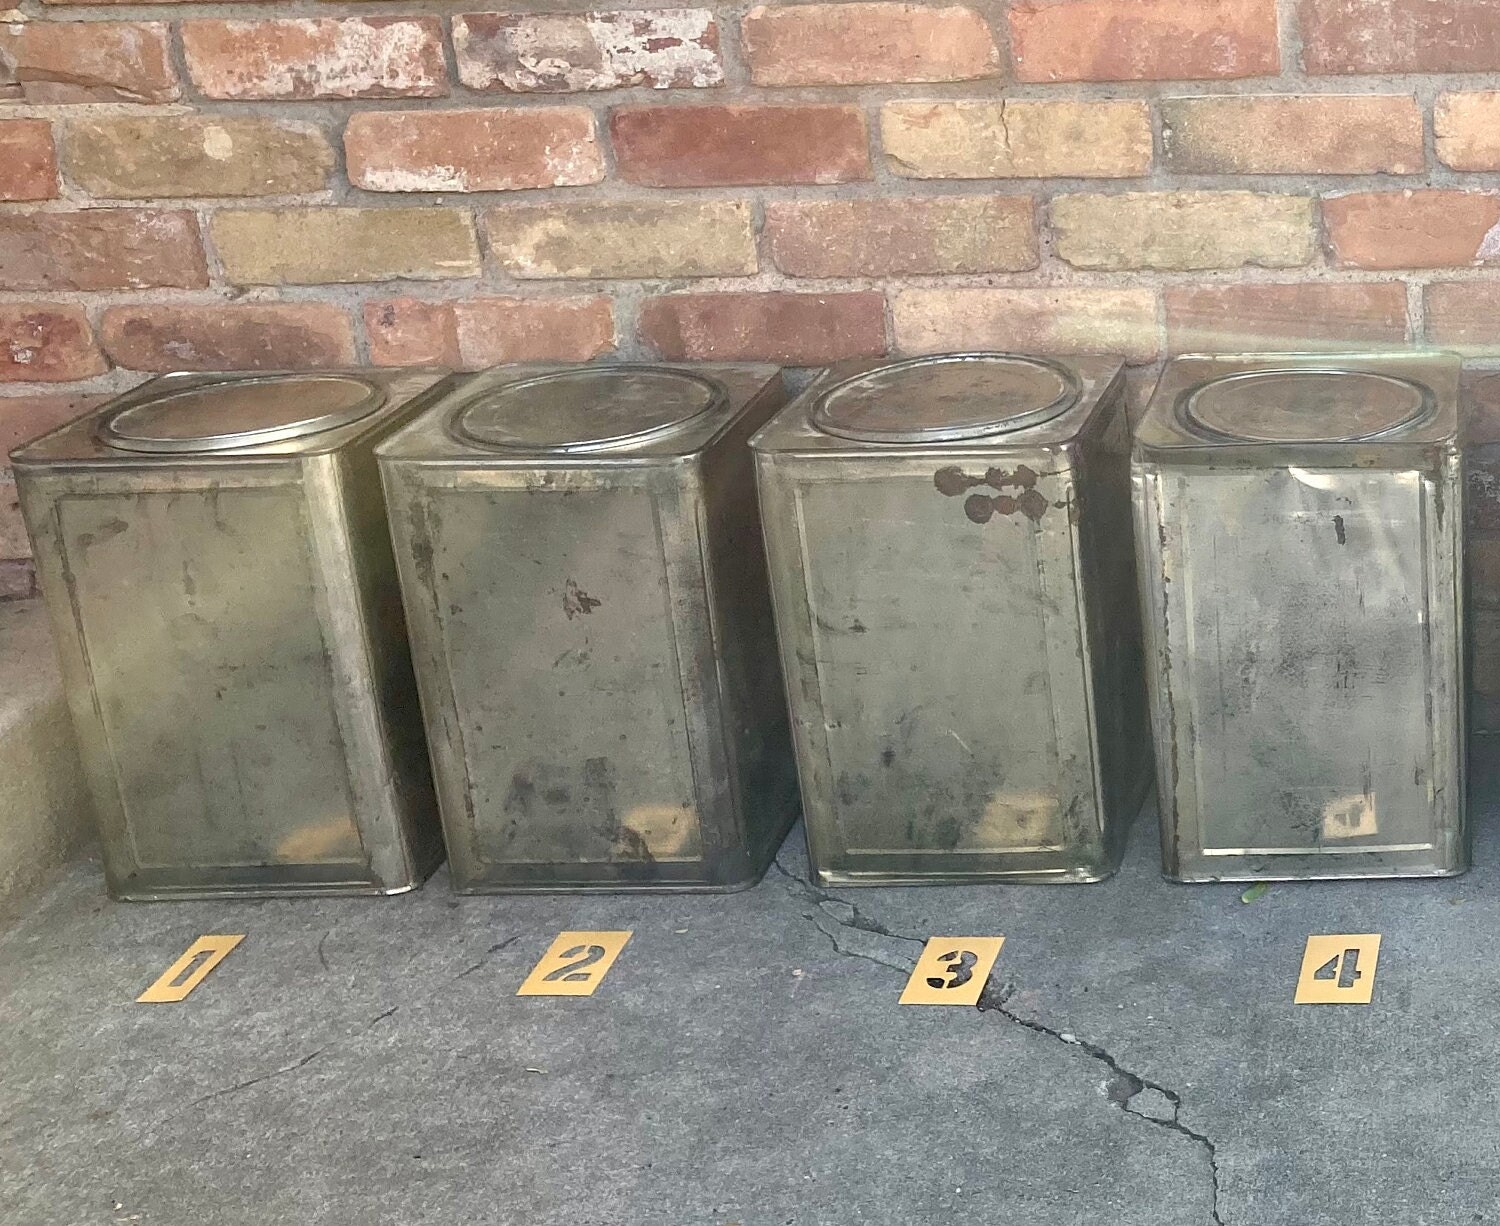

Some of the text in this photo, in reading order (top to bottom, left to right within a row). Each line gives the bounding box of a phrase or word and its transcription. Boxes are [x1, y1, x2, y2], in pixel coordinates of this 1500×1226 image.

[168, 949, 216, 987] 1
[542, 945, 606, 981] 2
[926, 950, 978, 988] 3
[1314, 949, 1361, 988] 4
